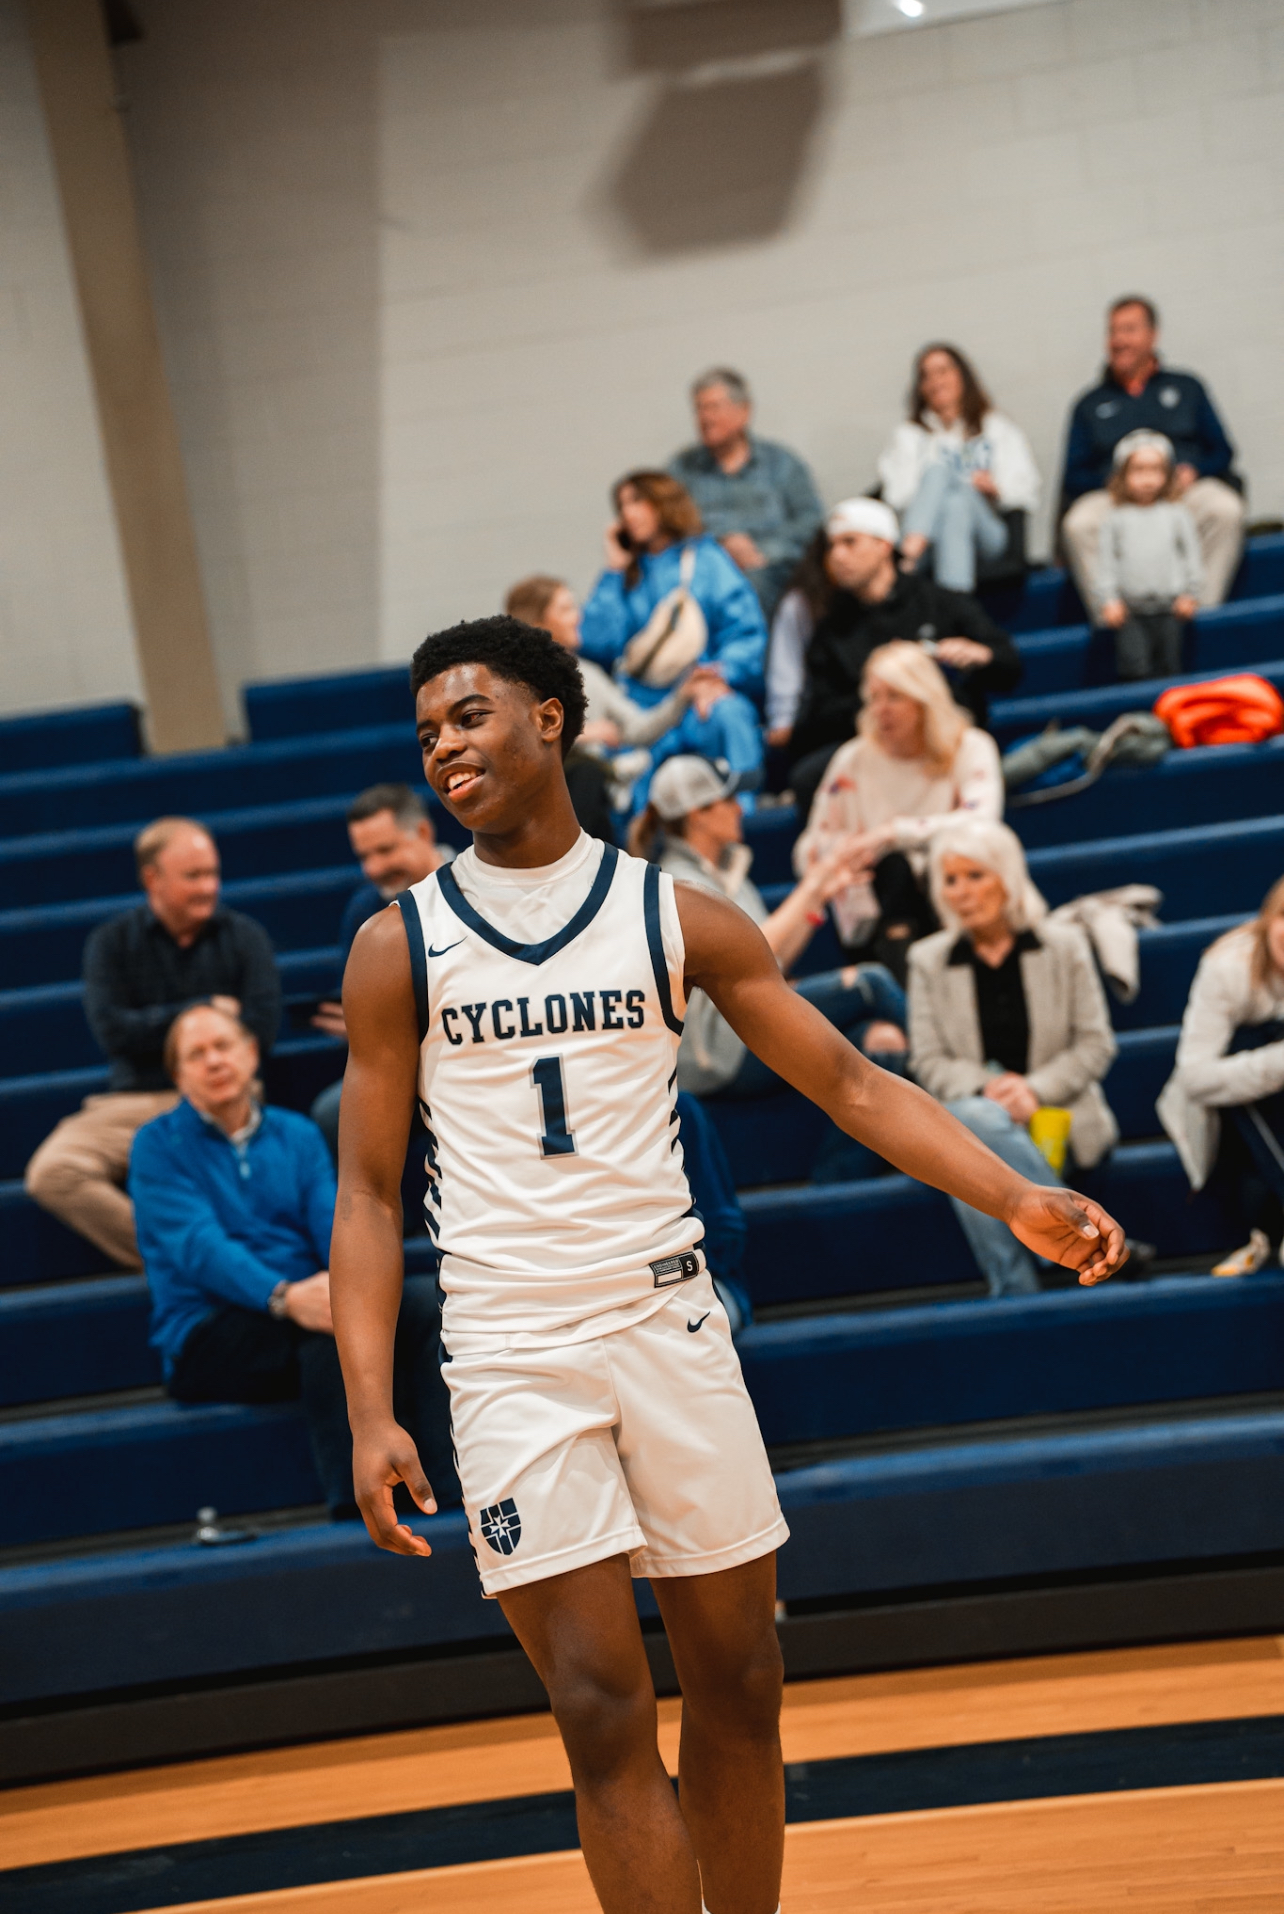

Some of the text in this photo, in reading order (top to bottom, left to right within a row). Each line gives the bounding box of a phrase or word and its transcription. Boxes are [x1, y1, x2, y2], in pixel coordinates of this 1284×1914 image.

[441, 989, 645, 1045] CYCLONES
[529, 1053, 579, 1160] 1
[686, 1260, 693, 1271] S
